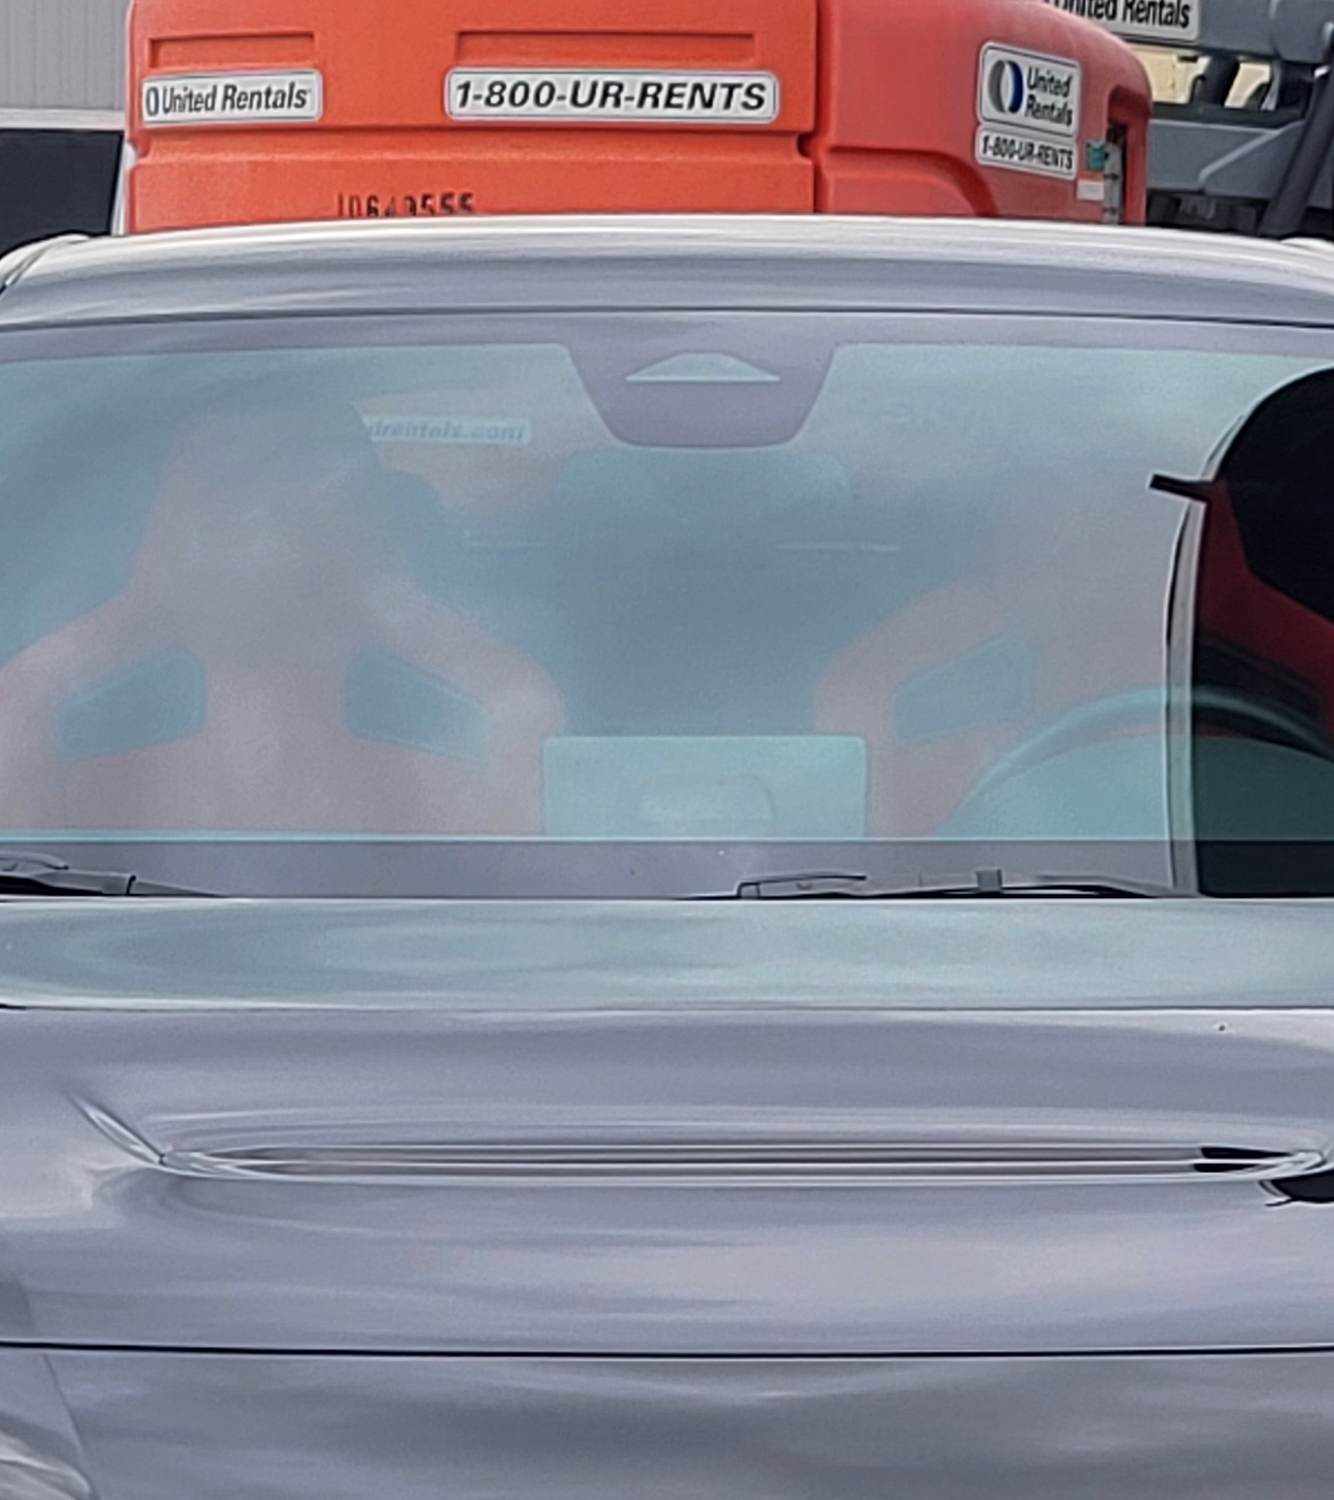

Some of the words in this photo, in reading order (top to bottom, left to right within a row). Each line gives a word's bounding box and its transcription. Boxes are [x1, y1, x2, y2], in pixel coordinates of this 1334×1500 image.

[1053, 0, 1117, 21] nited
[1122, 0, 1191, 28] Rentals
[162, 84, 218, 115] United
[221, 81, 308, 112] Rentals
[454, 79, 767, 111] 1-800-UR-RENTS
[1026, 66, 1073, 98] United
[1024, 94, 1073, 127] Rentals
[981, 135, 1073, 170] 1-800-UR-RENTS
